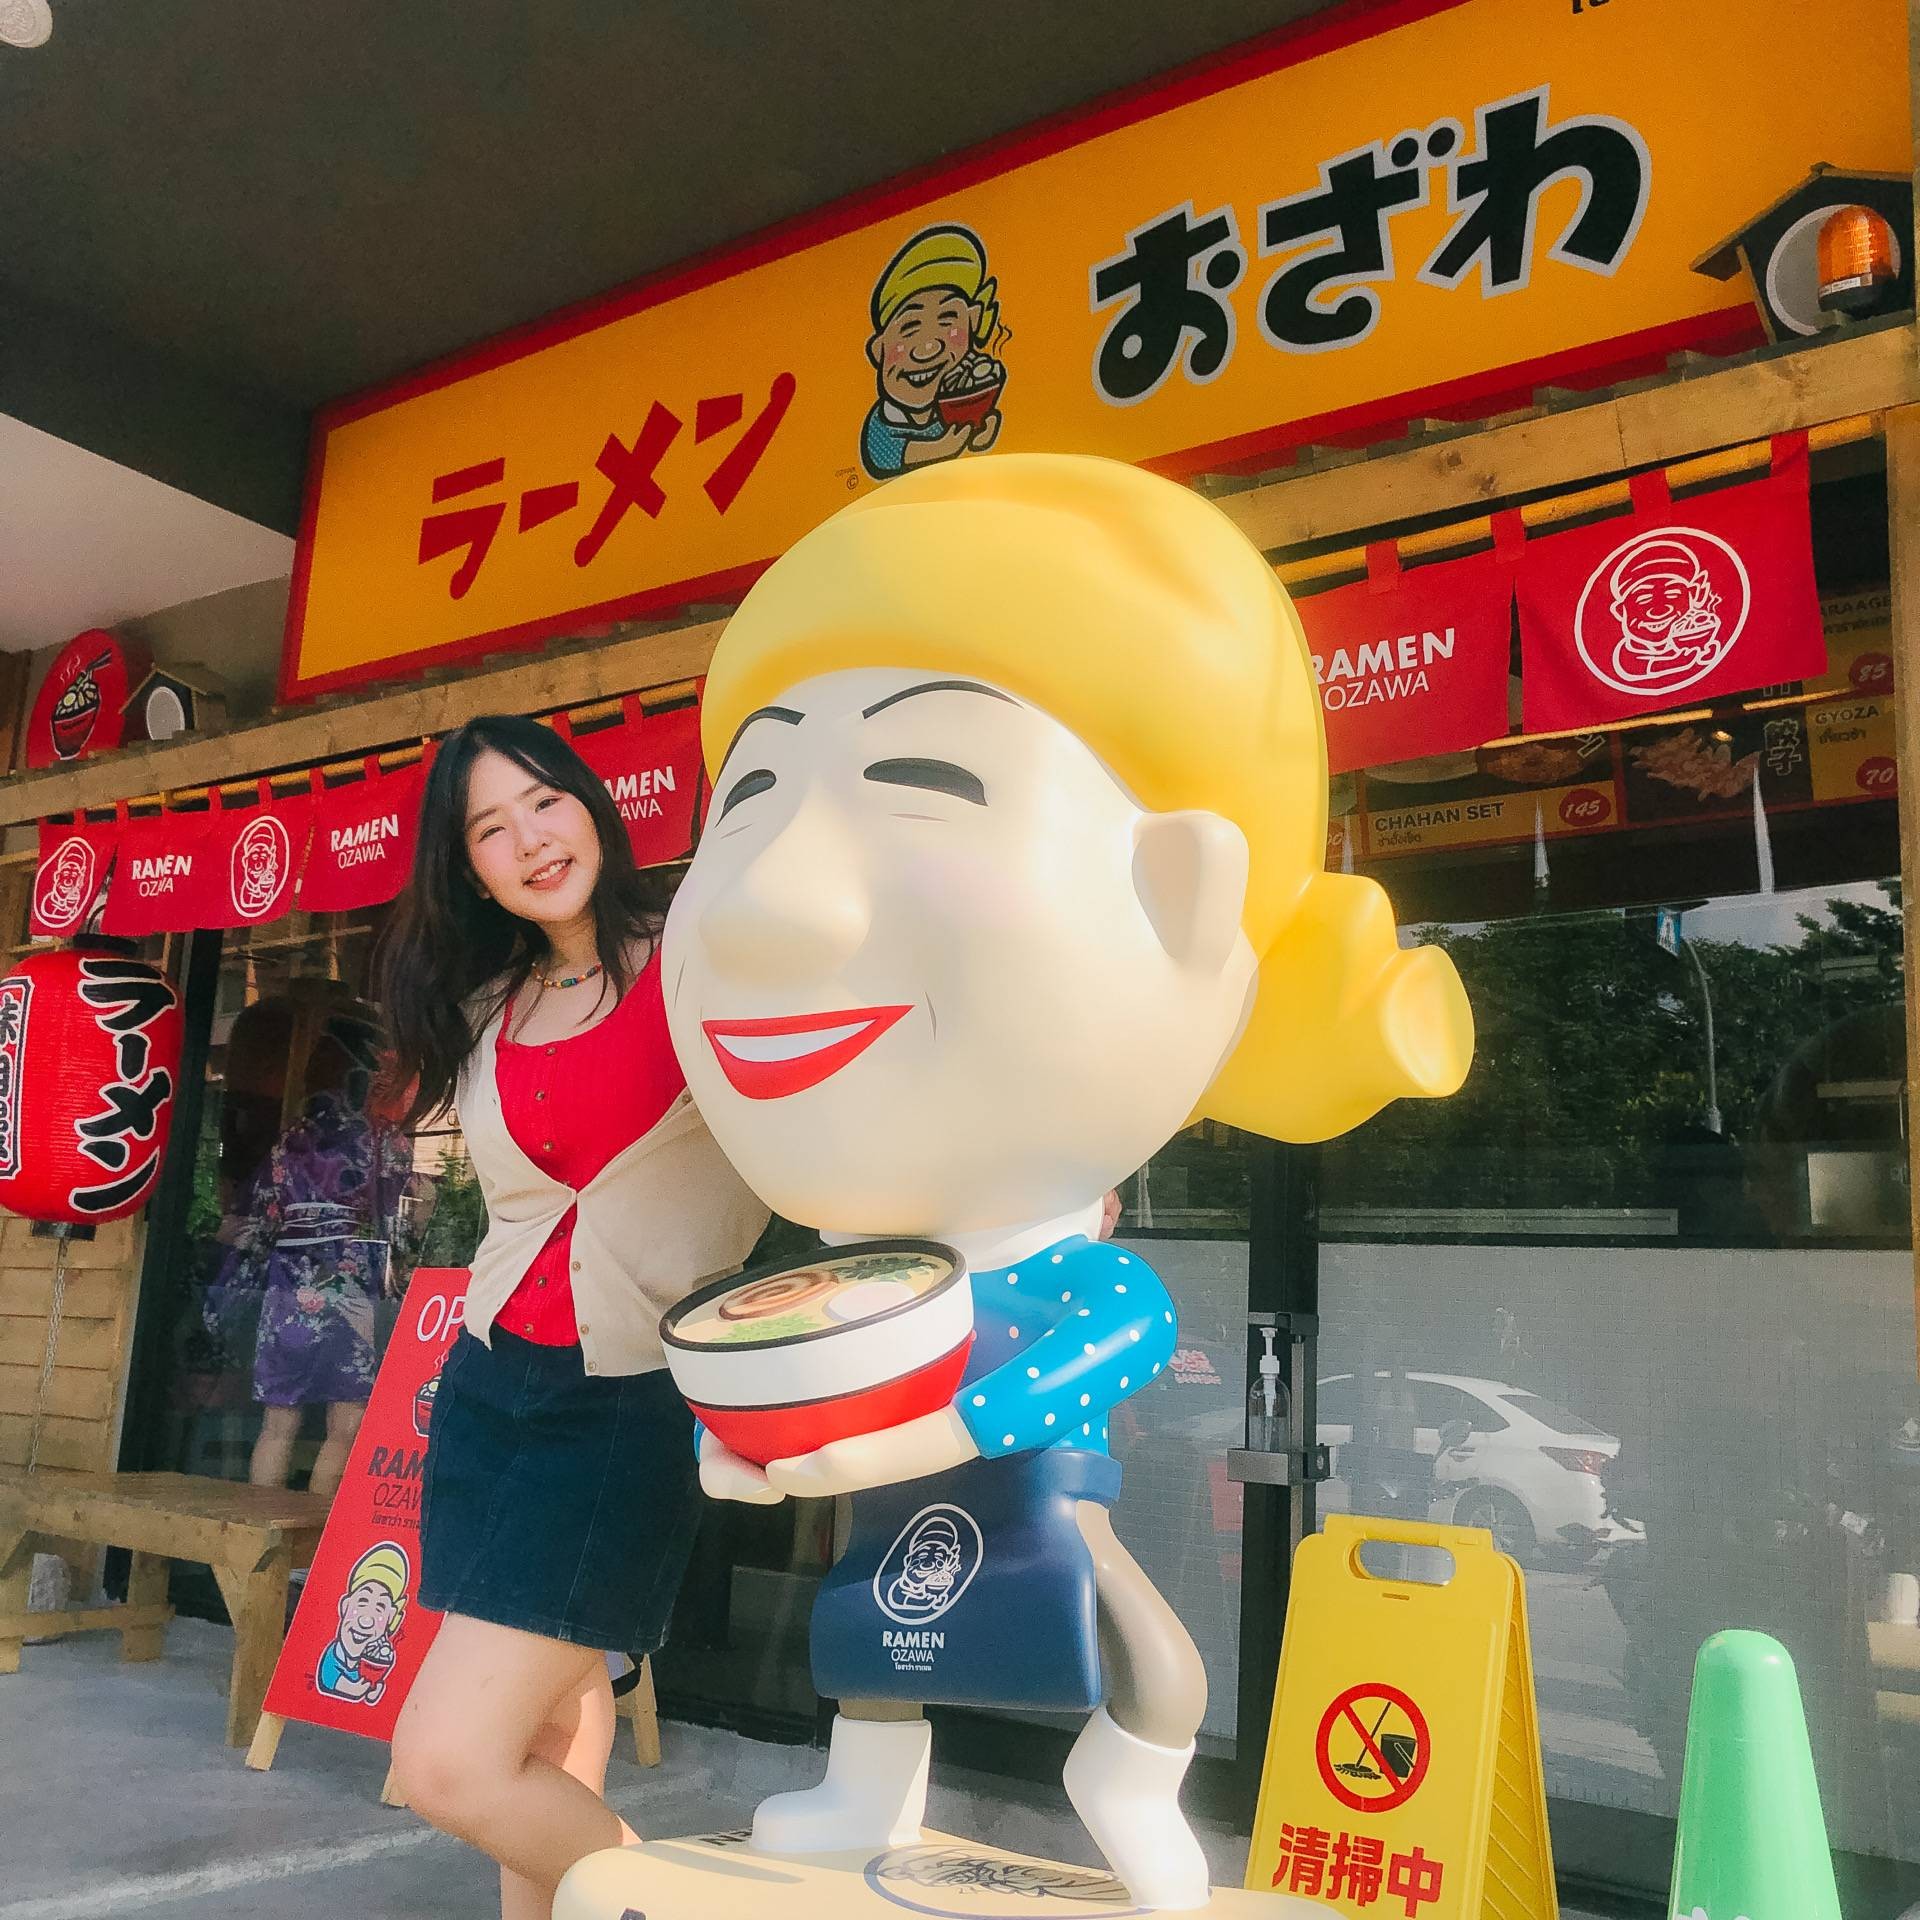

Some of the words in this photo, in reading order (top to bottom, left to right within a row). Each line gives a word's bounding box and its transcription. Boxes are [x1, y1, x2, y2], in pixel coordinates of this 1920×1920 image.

[1090, 84, 1652, 407] おざわ
[418, 372, 797, 600] ラーメン
[1311, 627, 1455, 686] RAMEN
[1858, 663, 1889, 682] 85
[1324, 670, 1430, 711] OZAWA
[1814, 705, 1880, 724] GYOZA
[1865, 767, 1895, 786] 70
[1375, 808, 1460, 832] CHAHAN
[1466, 802, 1505, 819] SET
[1565, 799, 1600, 817] 145
[330, 814, 399, 851] RAMEN
[338, 843, 386, 869] OZAWA
[68, 957, 178, 1214] ラーメン
[882, 1630, 945, 1649] RAMEN
[891, 1649, 934, 1663] OZAWA
[1272, 1823, 1444, 1919] 清掃中
